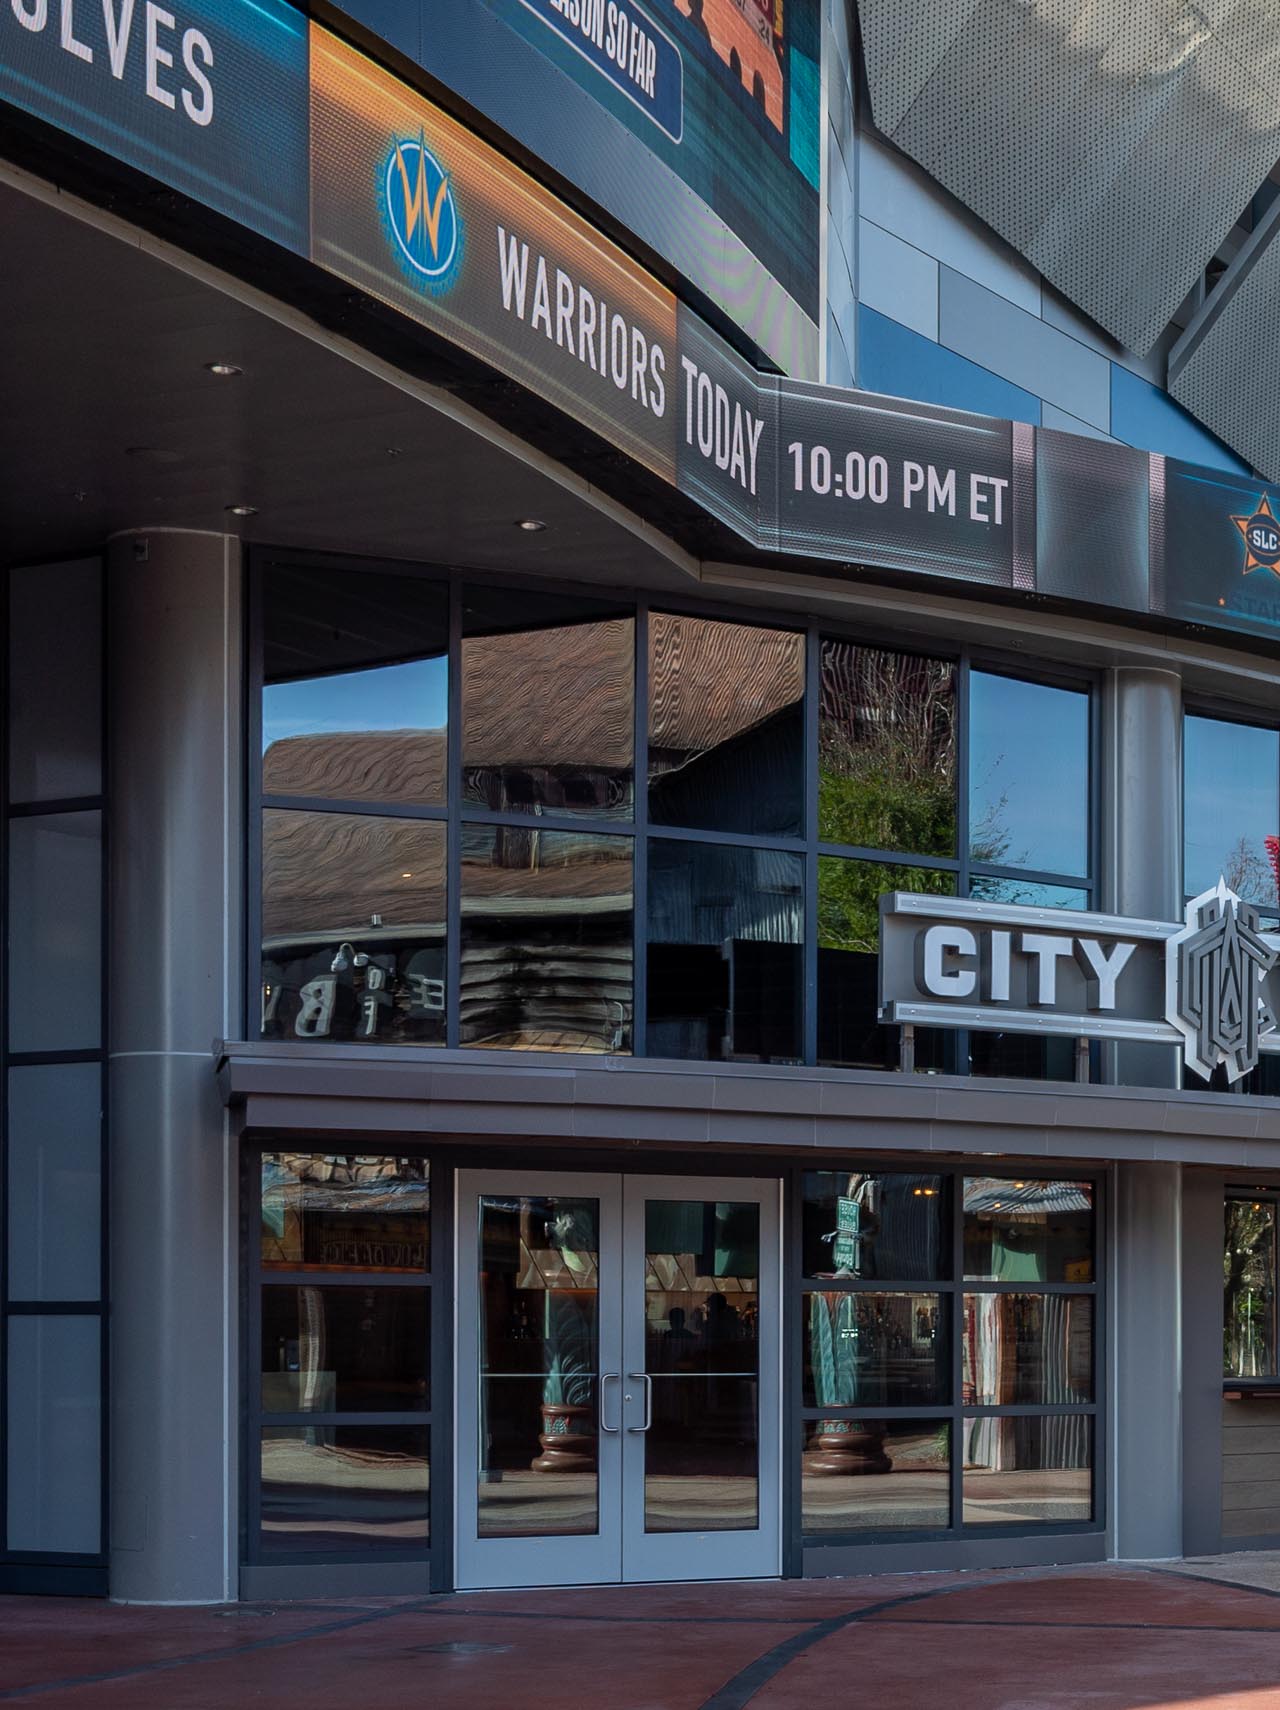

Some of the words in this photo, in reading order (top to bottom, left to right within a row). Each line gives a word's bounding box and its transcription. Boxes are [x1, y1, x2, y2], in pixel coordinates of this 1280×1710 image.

[606, 1, 628, 70] SO
[629, 22, 656, 99] FAR
[497, 225, 666, 418] WARRIORS
[681, 355, 765, 496] TODAY
[788, 442, 888, 504] 10:00
[903, 460, 956, 517] PM
[969, 472, 1009, 525] ET
[1252, 529, 1278, 551] SLC
[923, 925, 1138, 1010] CITY
